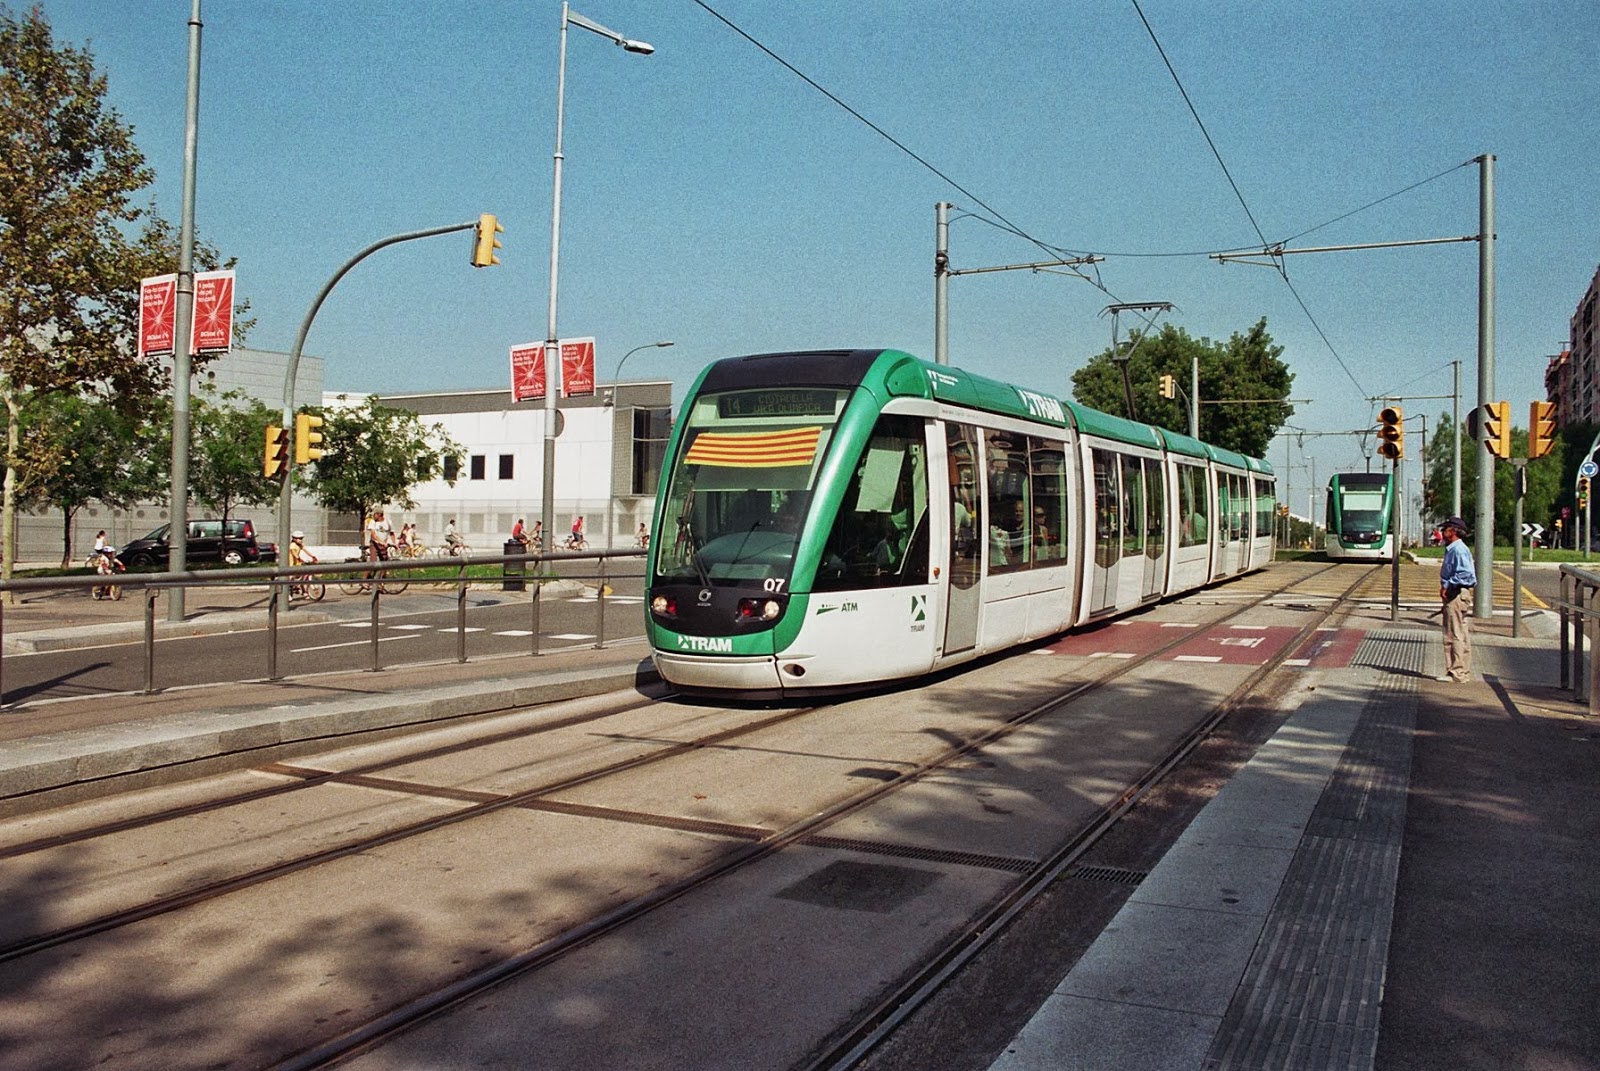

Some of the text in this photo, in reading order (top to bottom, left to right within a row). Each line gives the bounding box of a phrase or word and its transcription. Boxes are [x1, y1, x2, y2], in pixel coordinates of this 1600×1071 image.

[727, 397, 741, 414] T4
[758, 393, 813, 405] CIUTADELLA
[1029, 392, 1066, 422] TRAM
[763, 577, 786, 593] 07
[841, 602, 858, 613] ATM
[910, 624, 926, 632] TRAM
[690, 636, 732, 652] TRAM
